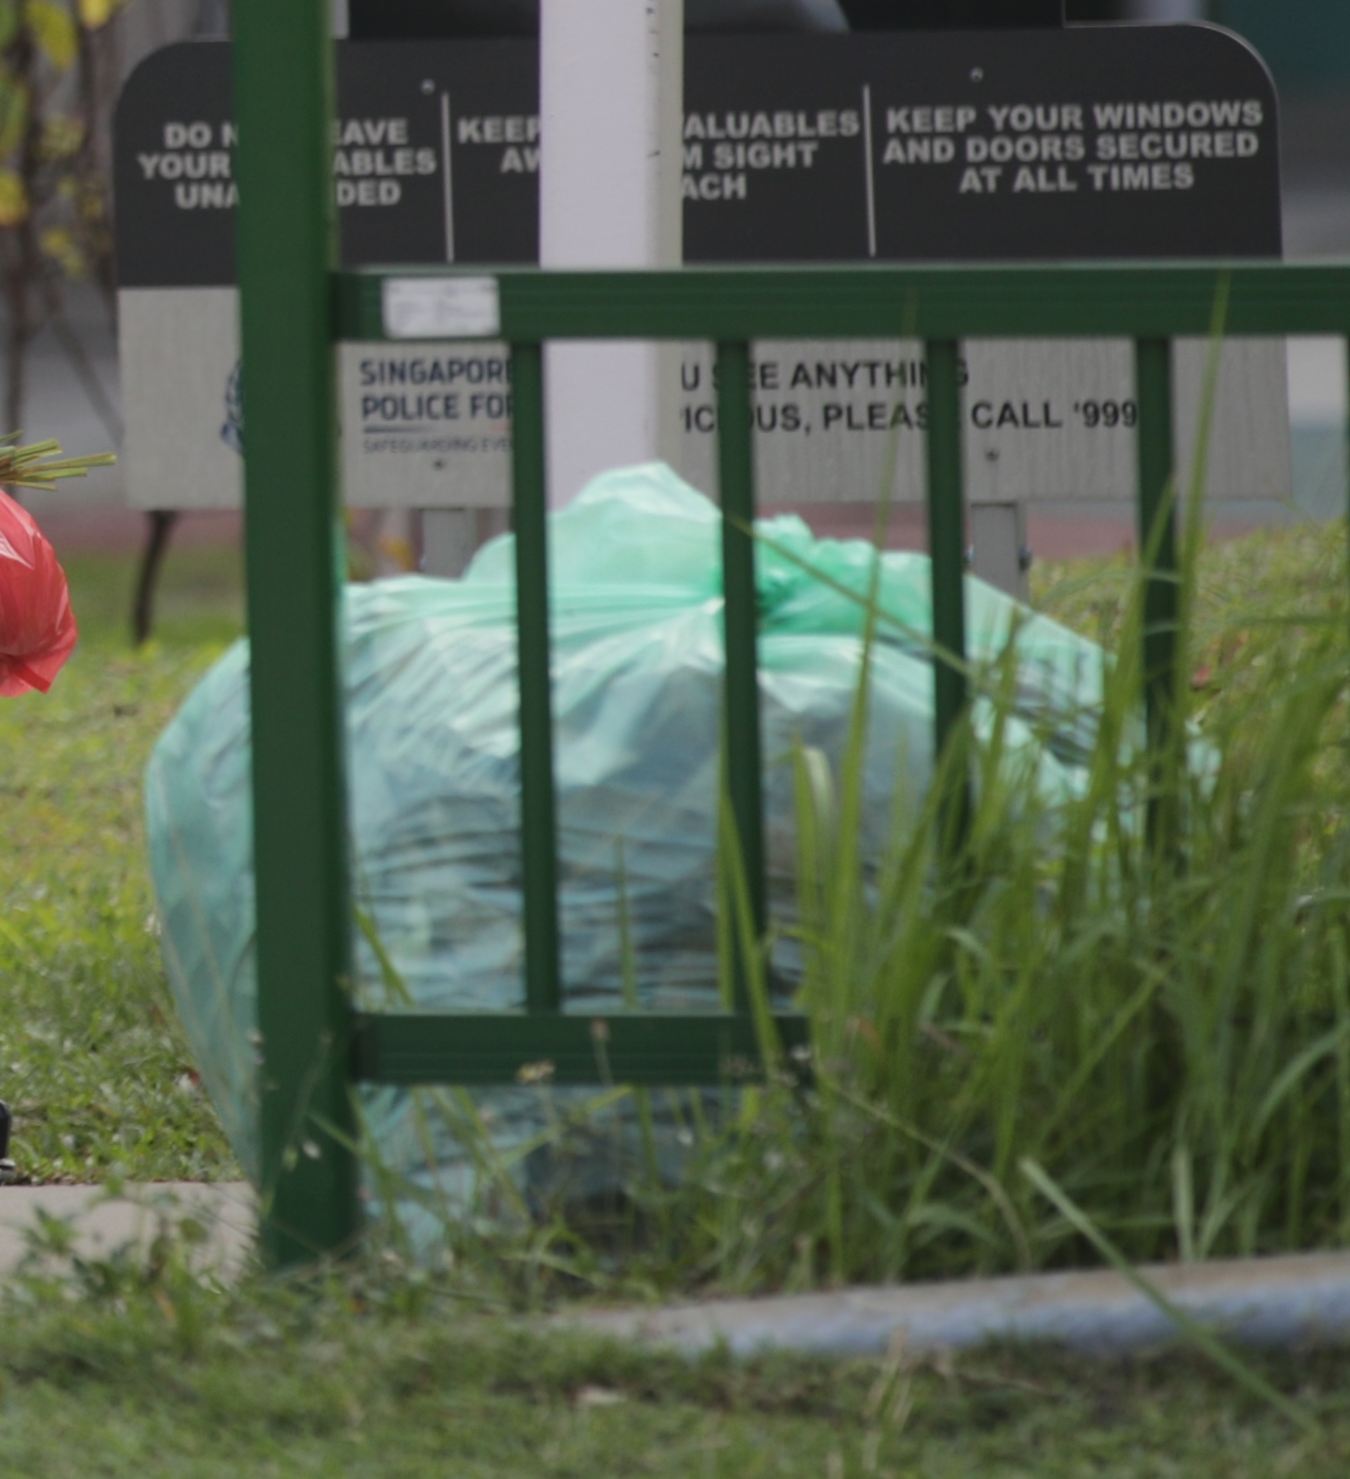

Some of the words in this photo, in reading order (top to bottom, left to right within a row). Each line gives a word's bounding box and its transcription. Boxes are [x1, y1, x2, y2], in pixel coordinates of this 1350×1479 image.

[683, 110, 860, 140] ALUABLES
[886, 107, 976, 133] KEEP
[989, 104, 1083, 131] YOUR
[1094, 100, 1263, 129] WINDOWS
[164, 122, 212, 148] DO
[333, 118, 408, 146] AVE
[883, 137, 954, 164] AND
[966, 136, 1085, 162] DOORS
[1096, 131, 1259, 159] SECURED
[137, 152, 232, 179] YOUR
[333, 147, 437, 176] ABLES
[713, 142, 818, 170] SIGHT
[682, 174, 747, 200] ACH
[959, 166, 1003, 193] AT
[1013, 165, 1077, 192] ALL
[1088, 162, 1195, 190] TIMES
[362, 392, 461, 421] POLICE
[823, 402, 928, 432] PLEAS
[971, 400, 1063, 429] CALL
